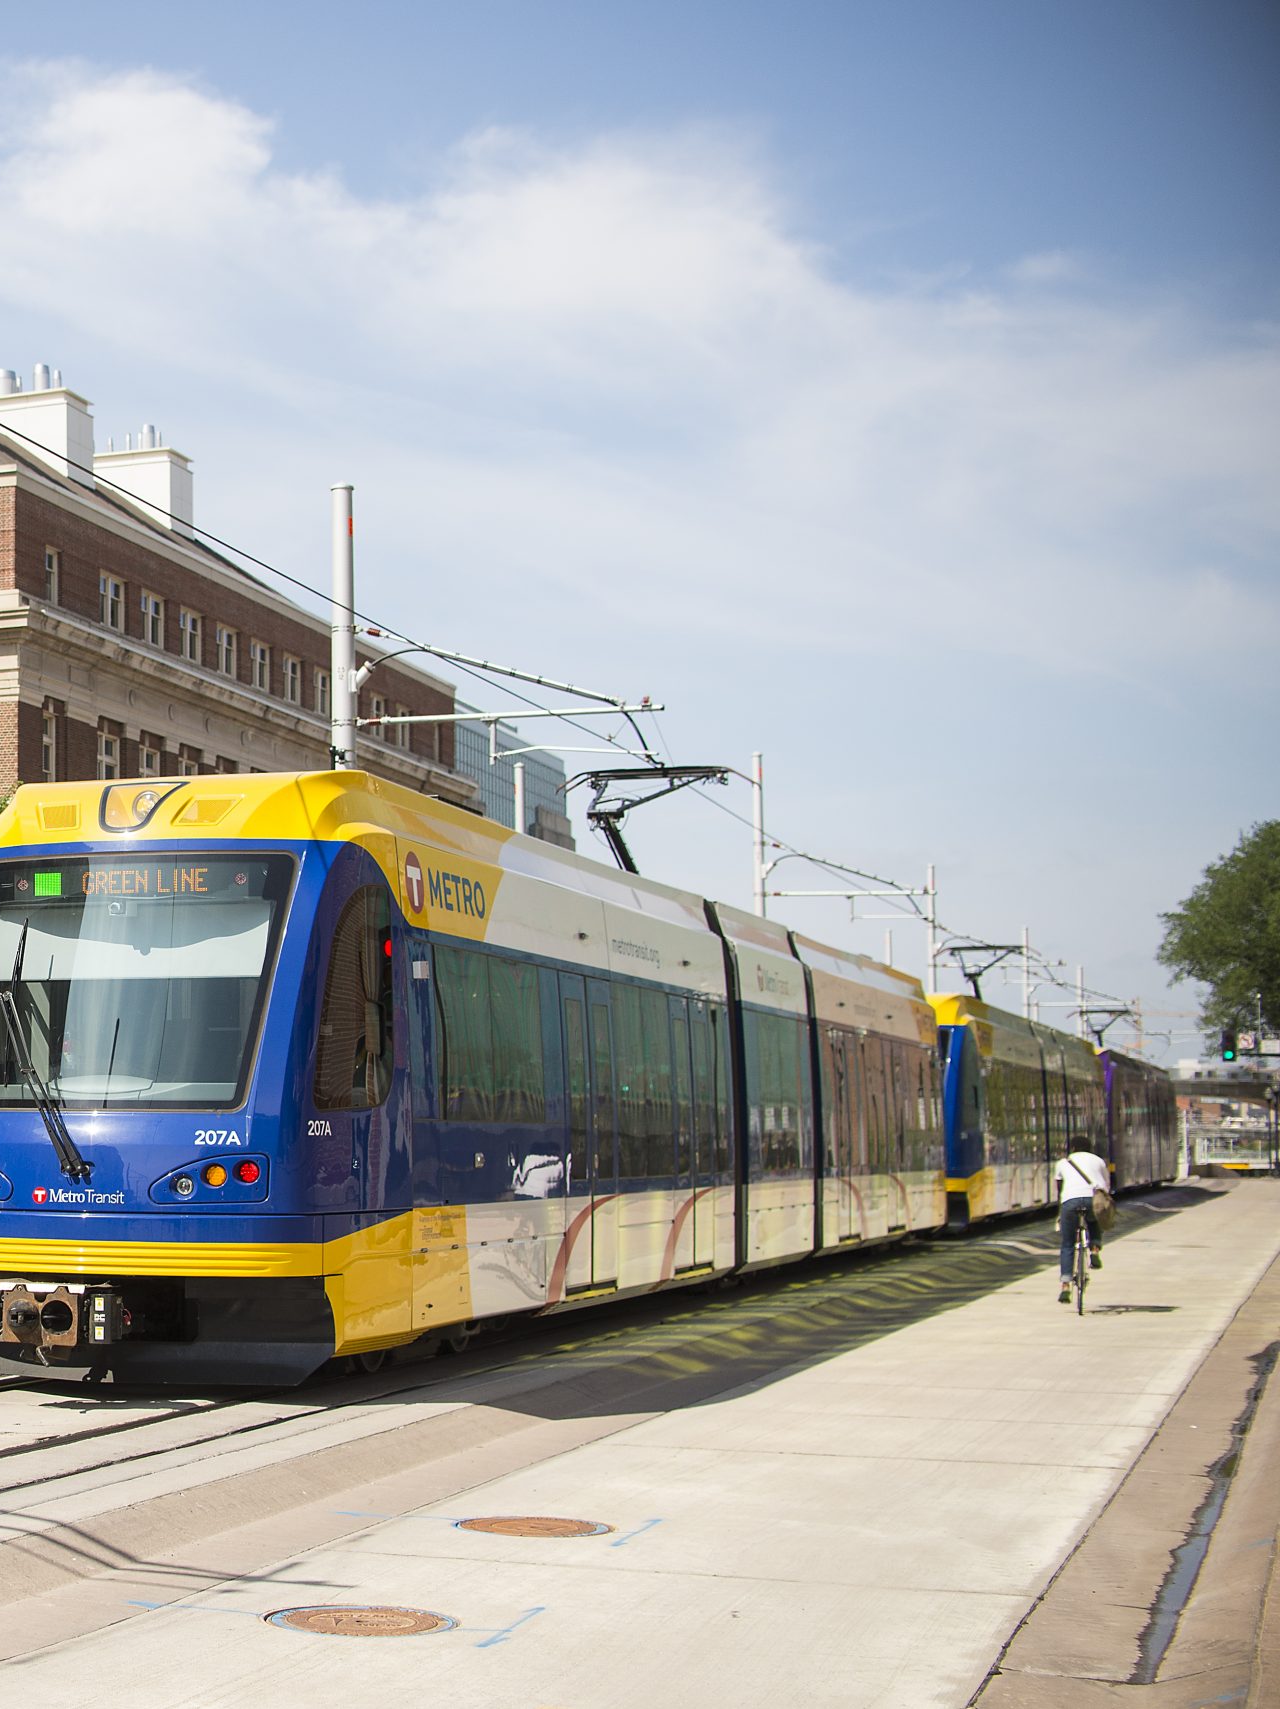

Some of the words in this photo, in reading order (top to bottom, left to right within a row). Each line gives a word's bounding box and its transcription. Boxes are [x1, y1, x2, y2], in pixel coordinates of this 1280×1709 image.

[82, 870, 148, 896] GREEN
[157, 867, 208, 893] LINE
[428, 867, 485, 919] METRO
[194, 1129, 241, 1146] 207A
[306, 1120, 332, 1136] 207A
